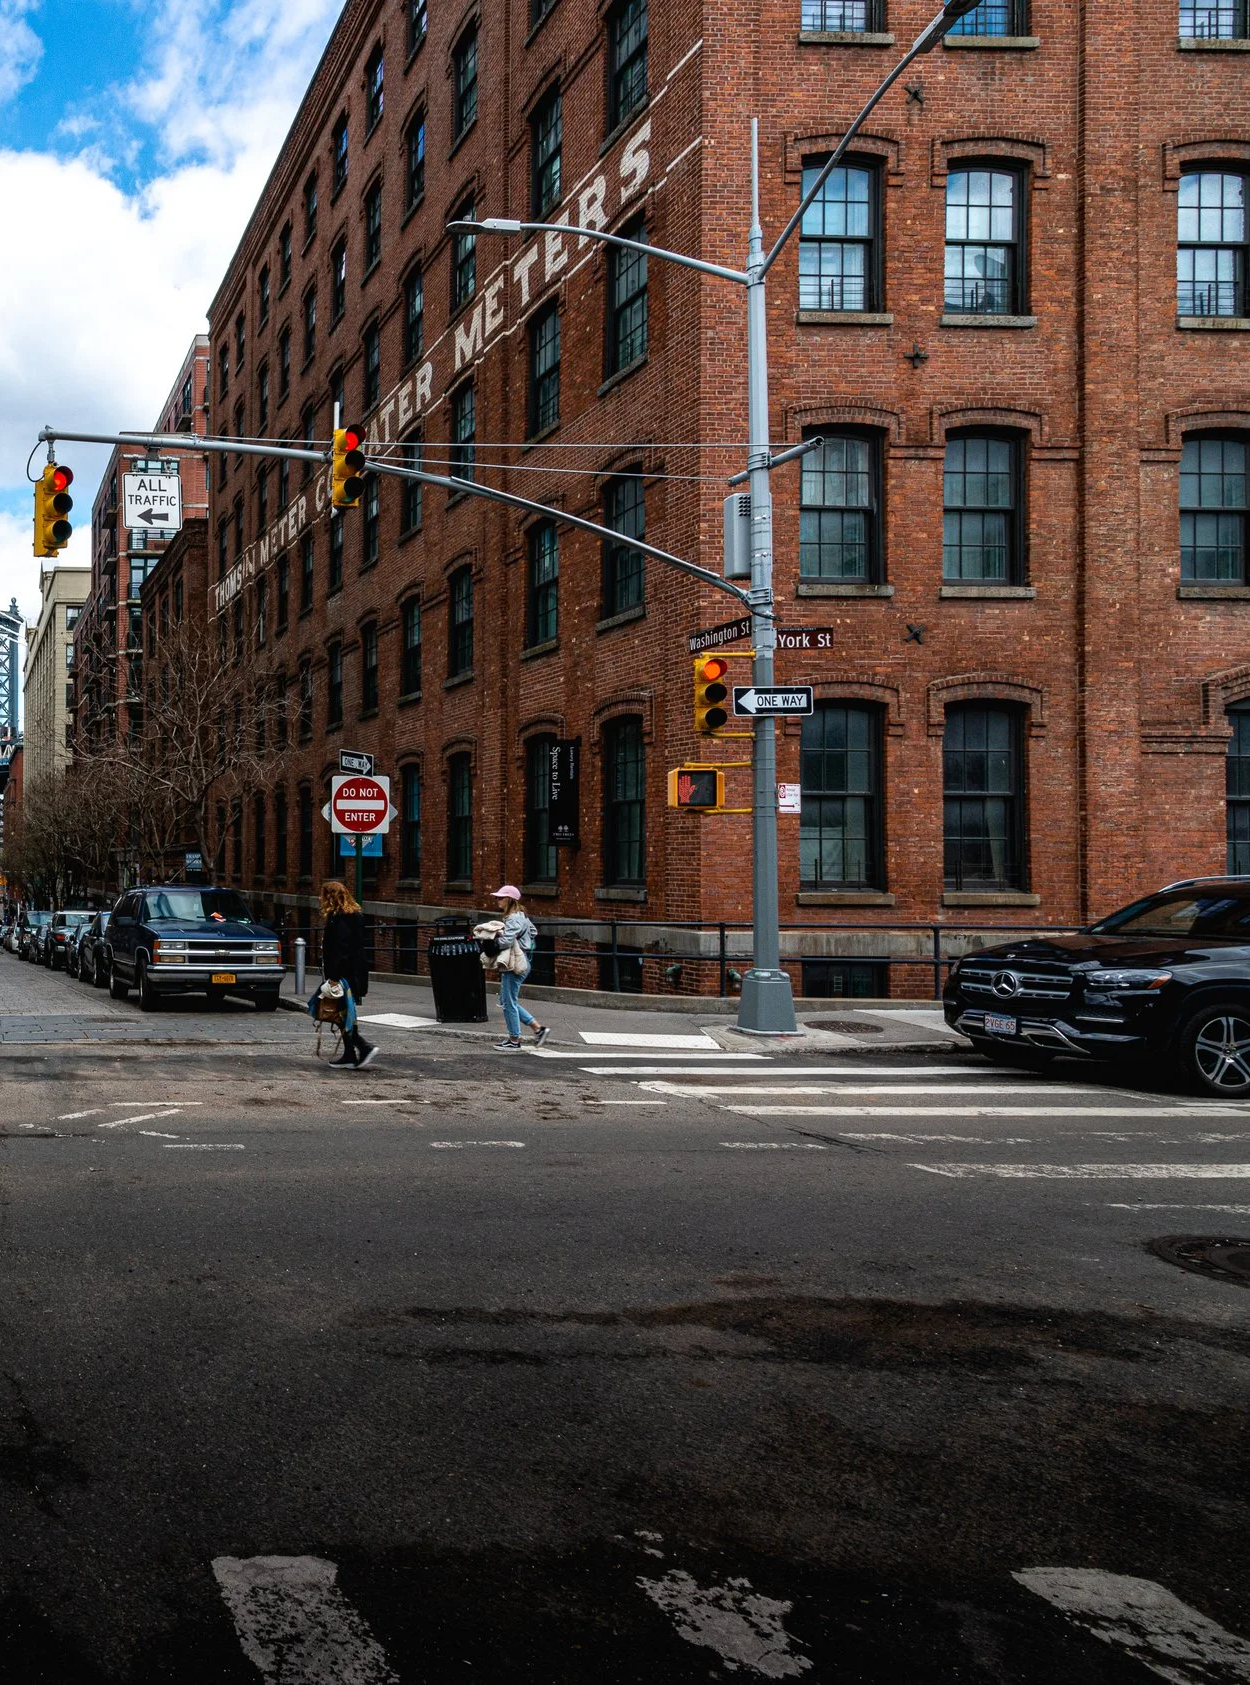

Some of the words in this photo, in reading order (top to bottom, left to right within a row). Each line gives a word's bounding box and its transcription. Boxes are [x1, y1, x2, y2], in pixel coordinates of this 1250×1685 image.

[260, 496, 306, 567] METER
[362, 362, 433, 457] ATER
[454, 117, 652, 374] METERS
[137, 479, 167, 492] ALL
[128, 495, 177, 506] TRAFFIC
[689, 626, 738, 651] Washington
[741, 620, 750, 635] St
[777, 633, 810, 648] York
[817, 633, 831, 647] St
[757, 695, 778, 707] ONE
[781, 696, 804, 706] WAY
[344, 757, 354, 767] ONE
[357, 759, 368, 769] WAY
[550, 746, 561, 770] Space
[552, 771, 558, 780] to
[342, 788, 356, 797] DO
[359, 788, 378, 797] NOT
[551, 782, 561, 800] Live
[344, 812, 376, 822] ENTER
